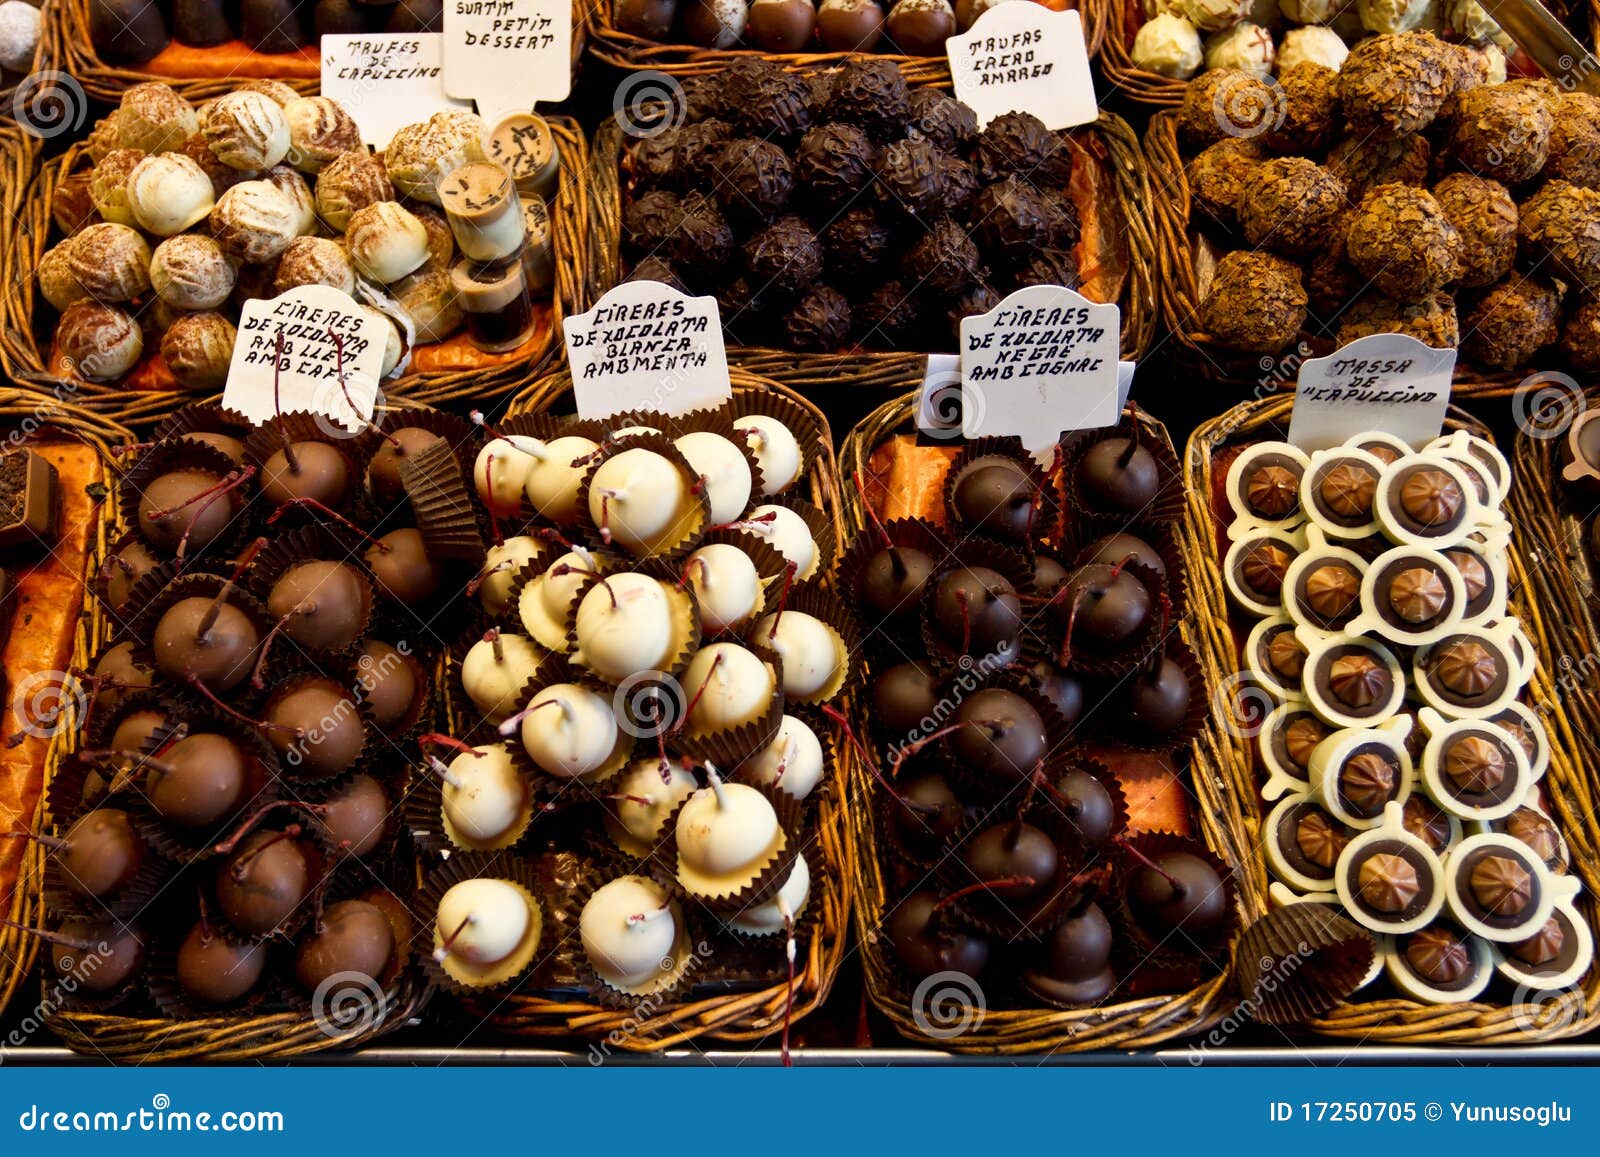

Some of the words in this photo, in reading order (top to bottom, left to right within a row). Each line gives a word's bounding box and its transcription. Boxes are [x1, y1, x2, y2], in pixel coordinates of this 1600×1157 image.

[456, 1, 513, 17] SURTIT
[347, 41, 420, 55] TRUFES
[465, 30, 554, 49] DESSERT
[969, 29, 1042, 56] TRUFAS
[368, 56, 391, 68] DE
[973, 50, 1035, 71] CACAO
[980, 63, 1053, 86] AMARGO
[244, 317, 271, 331] DE
[571, 330, 597, 347] DE
[602, 316, 708, 345] XOCOLATA
[606, 337, 691, 359] BLANCA
[969, 332, 995, 351] DE
[1000, 328, 1104, 347] XOCOLATA
[244, 351, 291, 371] AMB
[995, 344, 1075, 364] NEGRE
[969, 365, 1013, 381] AMB
[1019, 358, 1103, 377] COGNAC
[1335, 359, 1414, 376] TASSA
[1348, 376, 1379, 388] DE
